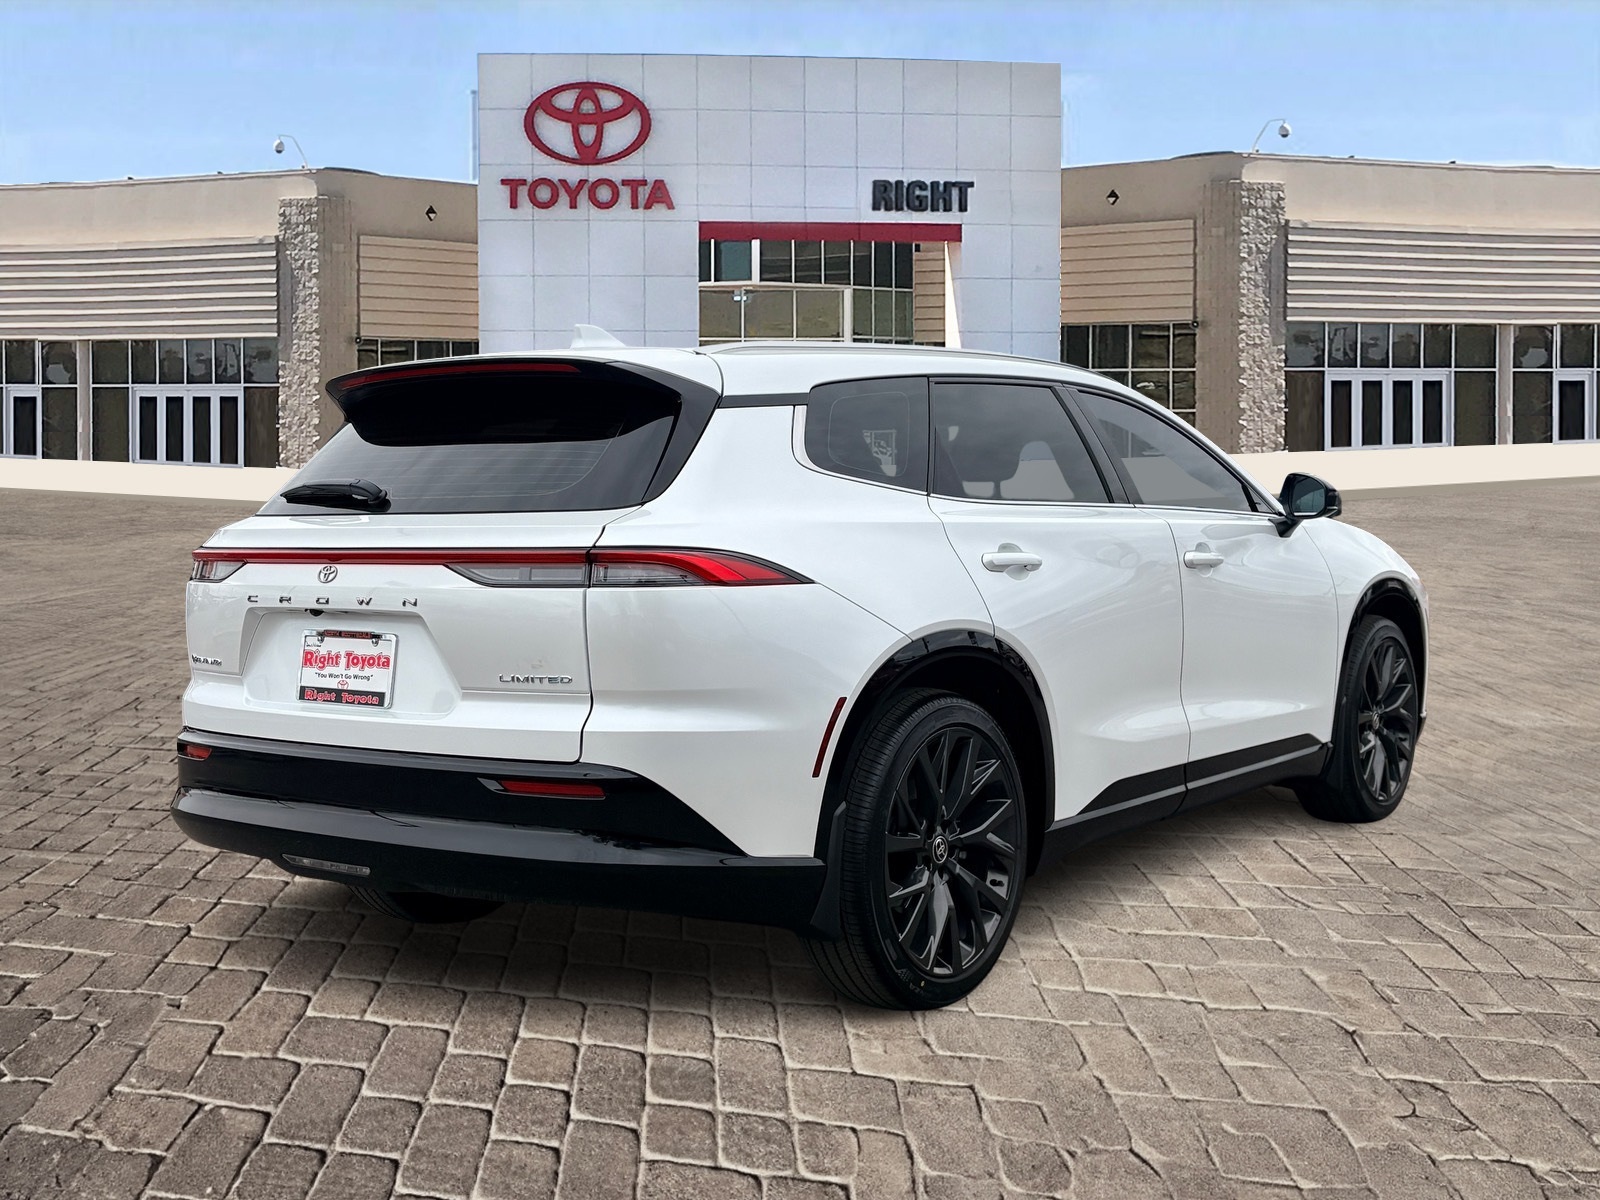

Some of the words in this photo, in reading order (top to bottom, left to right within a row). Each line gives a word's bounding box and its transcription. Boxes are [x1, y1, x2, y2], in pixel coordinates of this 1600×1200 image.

[500, 177, 675, 210] TOYOTA
[871, 179, 975, 213] RIGHT
[247, 594, 418, 607] CROWN
[303, 648, 341, 671] Right
[344, 651, 391, 671] Toyota
[499, 674, 573, 684] LIMITED
[304, 688, 336, 702] Right
[341, 692, 379, 704] Toyota
